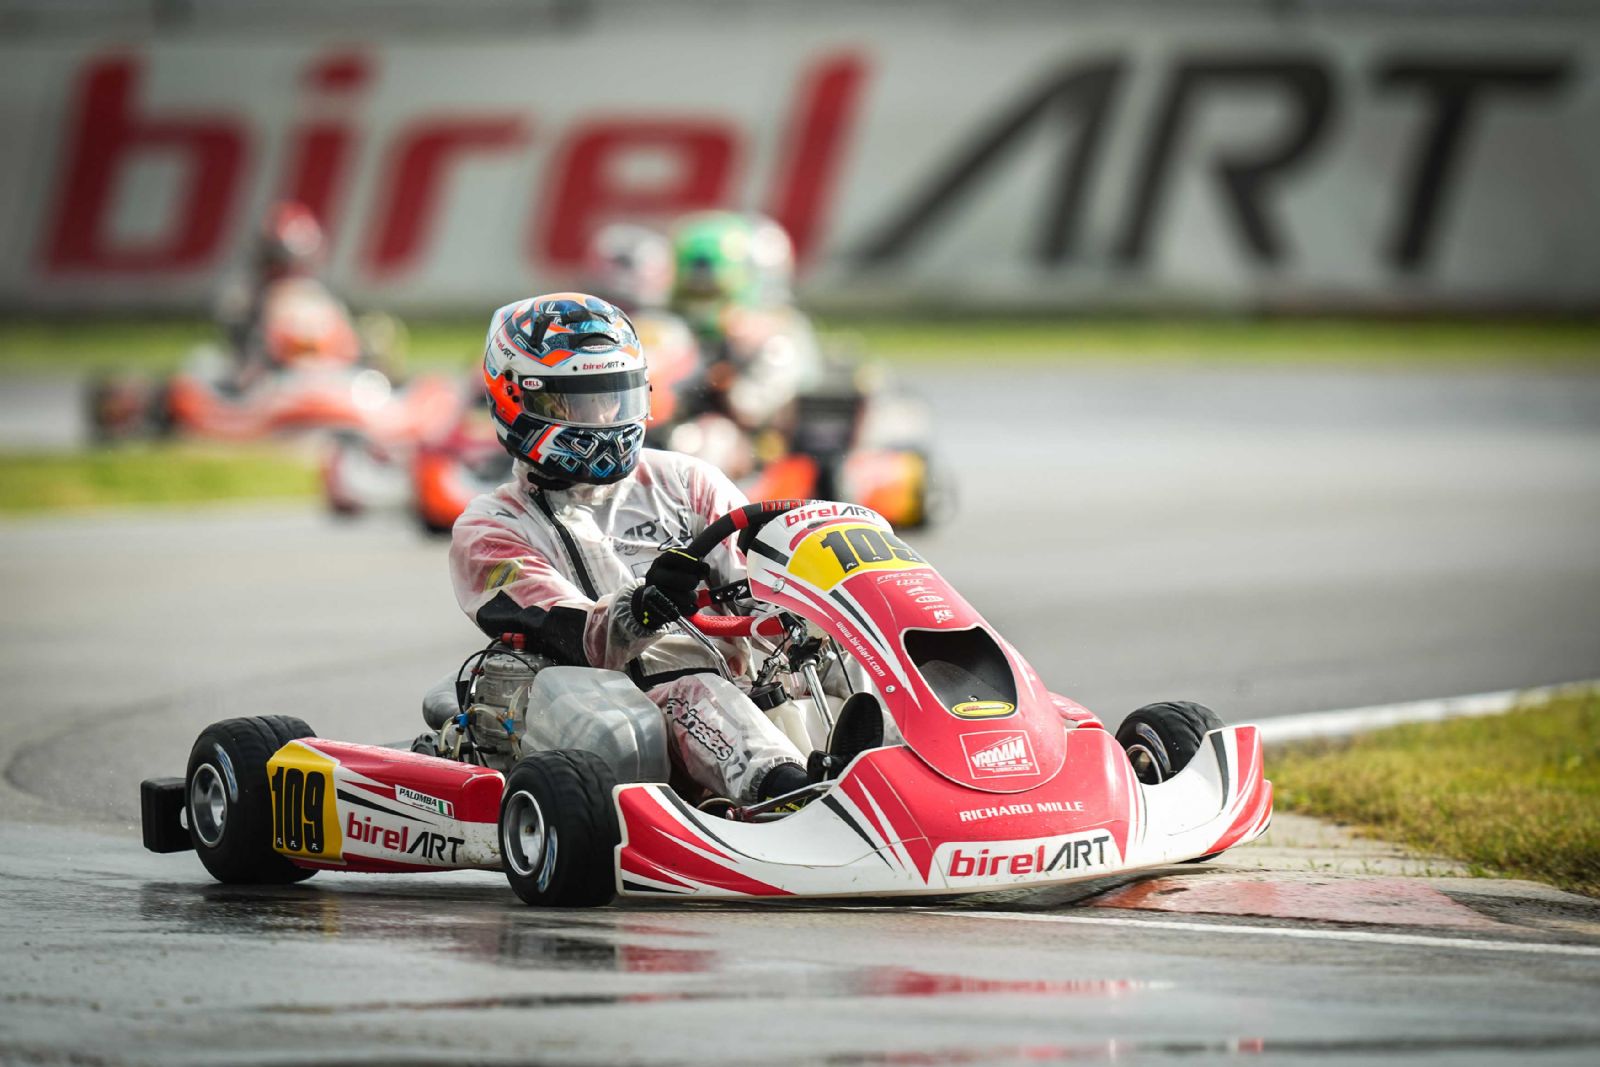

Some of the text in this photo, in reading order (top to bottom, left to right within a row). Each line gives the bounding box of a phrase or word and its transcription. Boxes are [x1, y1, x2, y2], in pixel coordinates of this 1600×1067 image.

[40, 46, 1570, 274] birelART
[583, 361, 619, 370] birelART
[785, 504, 877, 528] birelART
[835, 621, 886, 678] www.birelart.com
[271, 766, 326, 855] 109
[399, 787, 437, 807] PALOMBA
[959, 801, 1085, 823] RICHARD MILLE
[347, 811, 465, 863] birelART
[947, 835, 1110, 877] birelART
